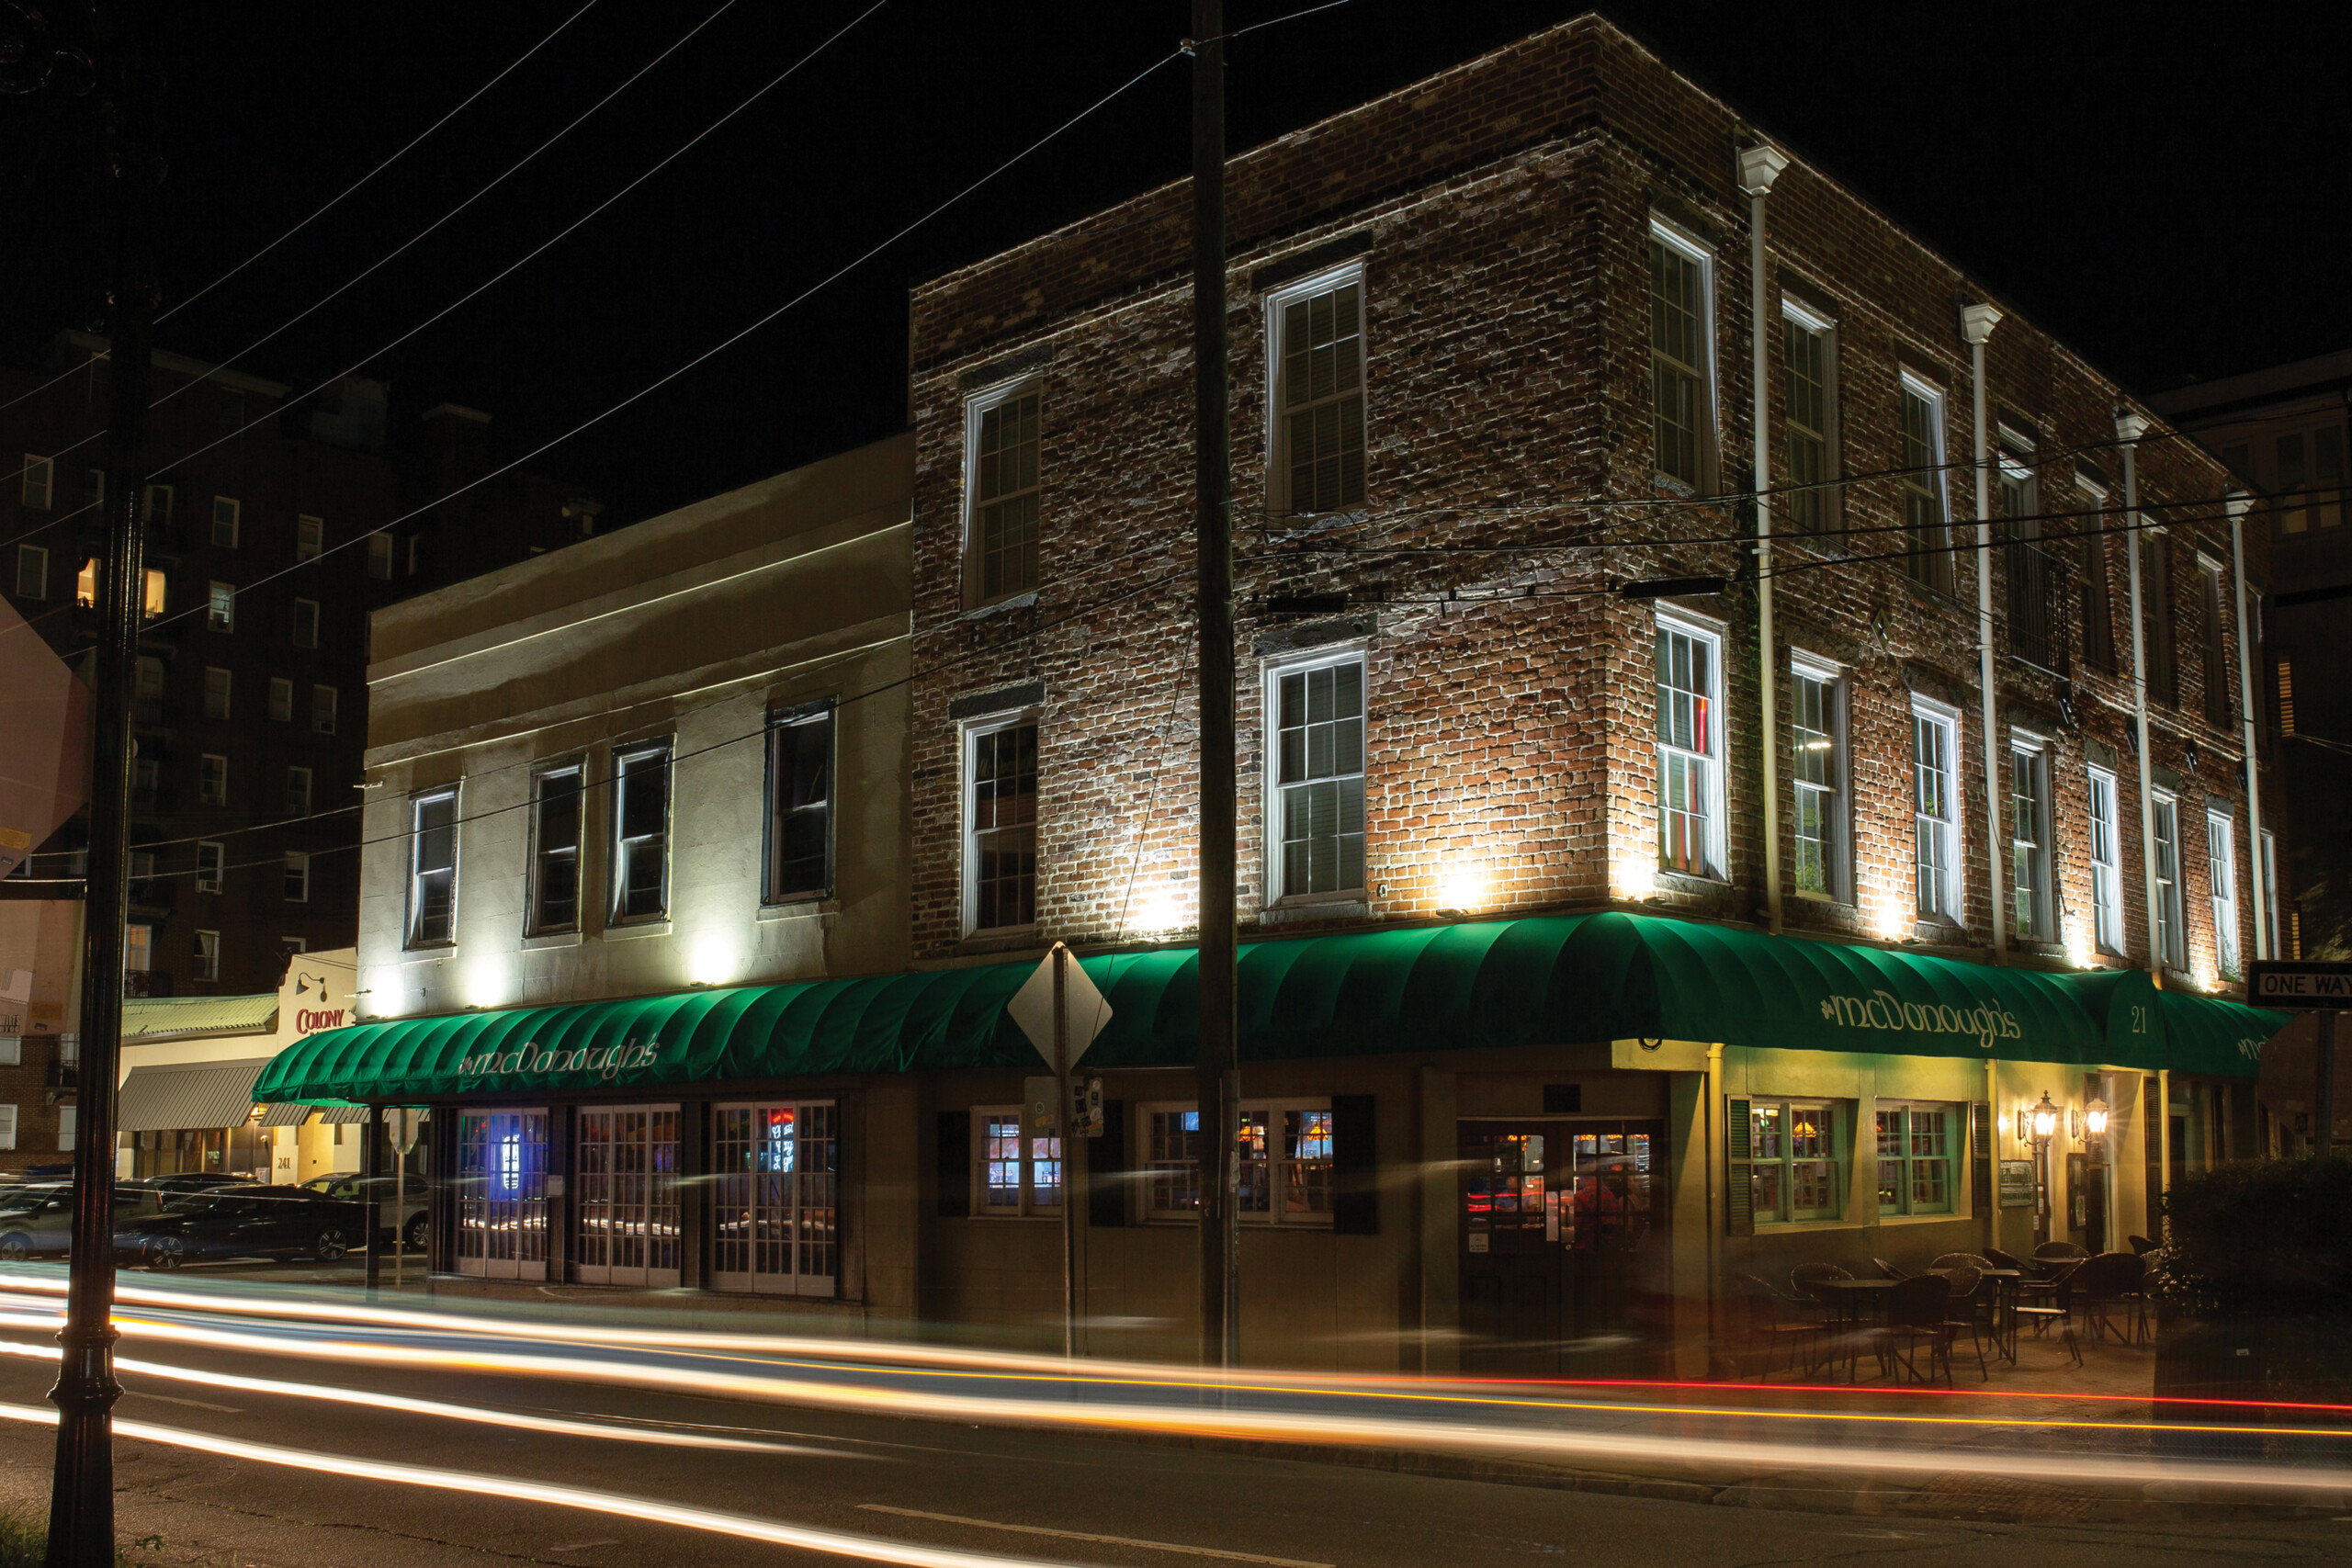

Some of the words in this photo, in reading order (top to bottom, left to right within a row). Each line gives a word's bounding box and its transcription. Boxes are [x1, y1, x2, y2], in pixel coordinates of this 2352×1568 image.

[2265, 975, 2306, 994] ONE
[296, 1009, 345, 1034] COLONY
[2132, 1005, 2147, 1033] 21
[277, 1157, 290, 1169] 241
